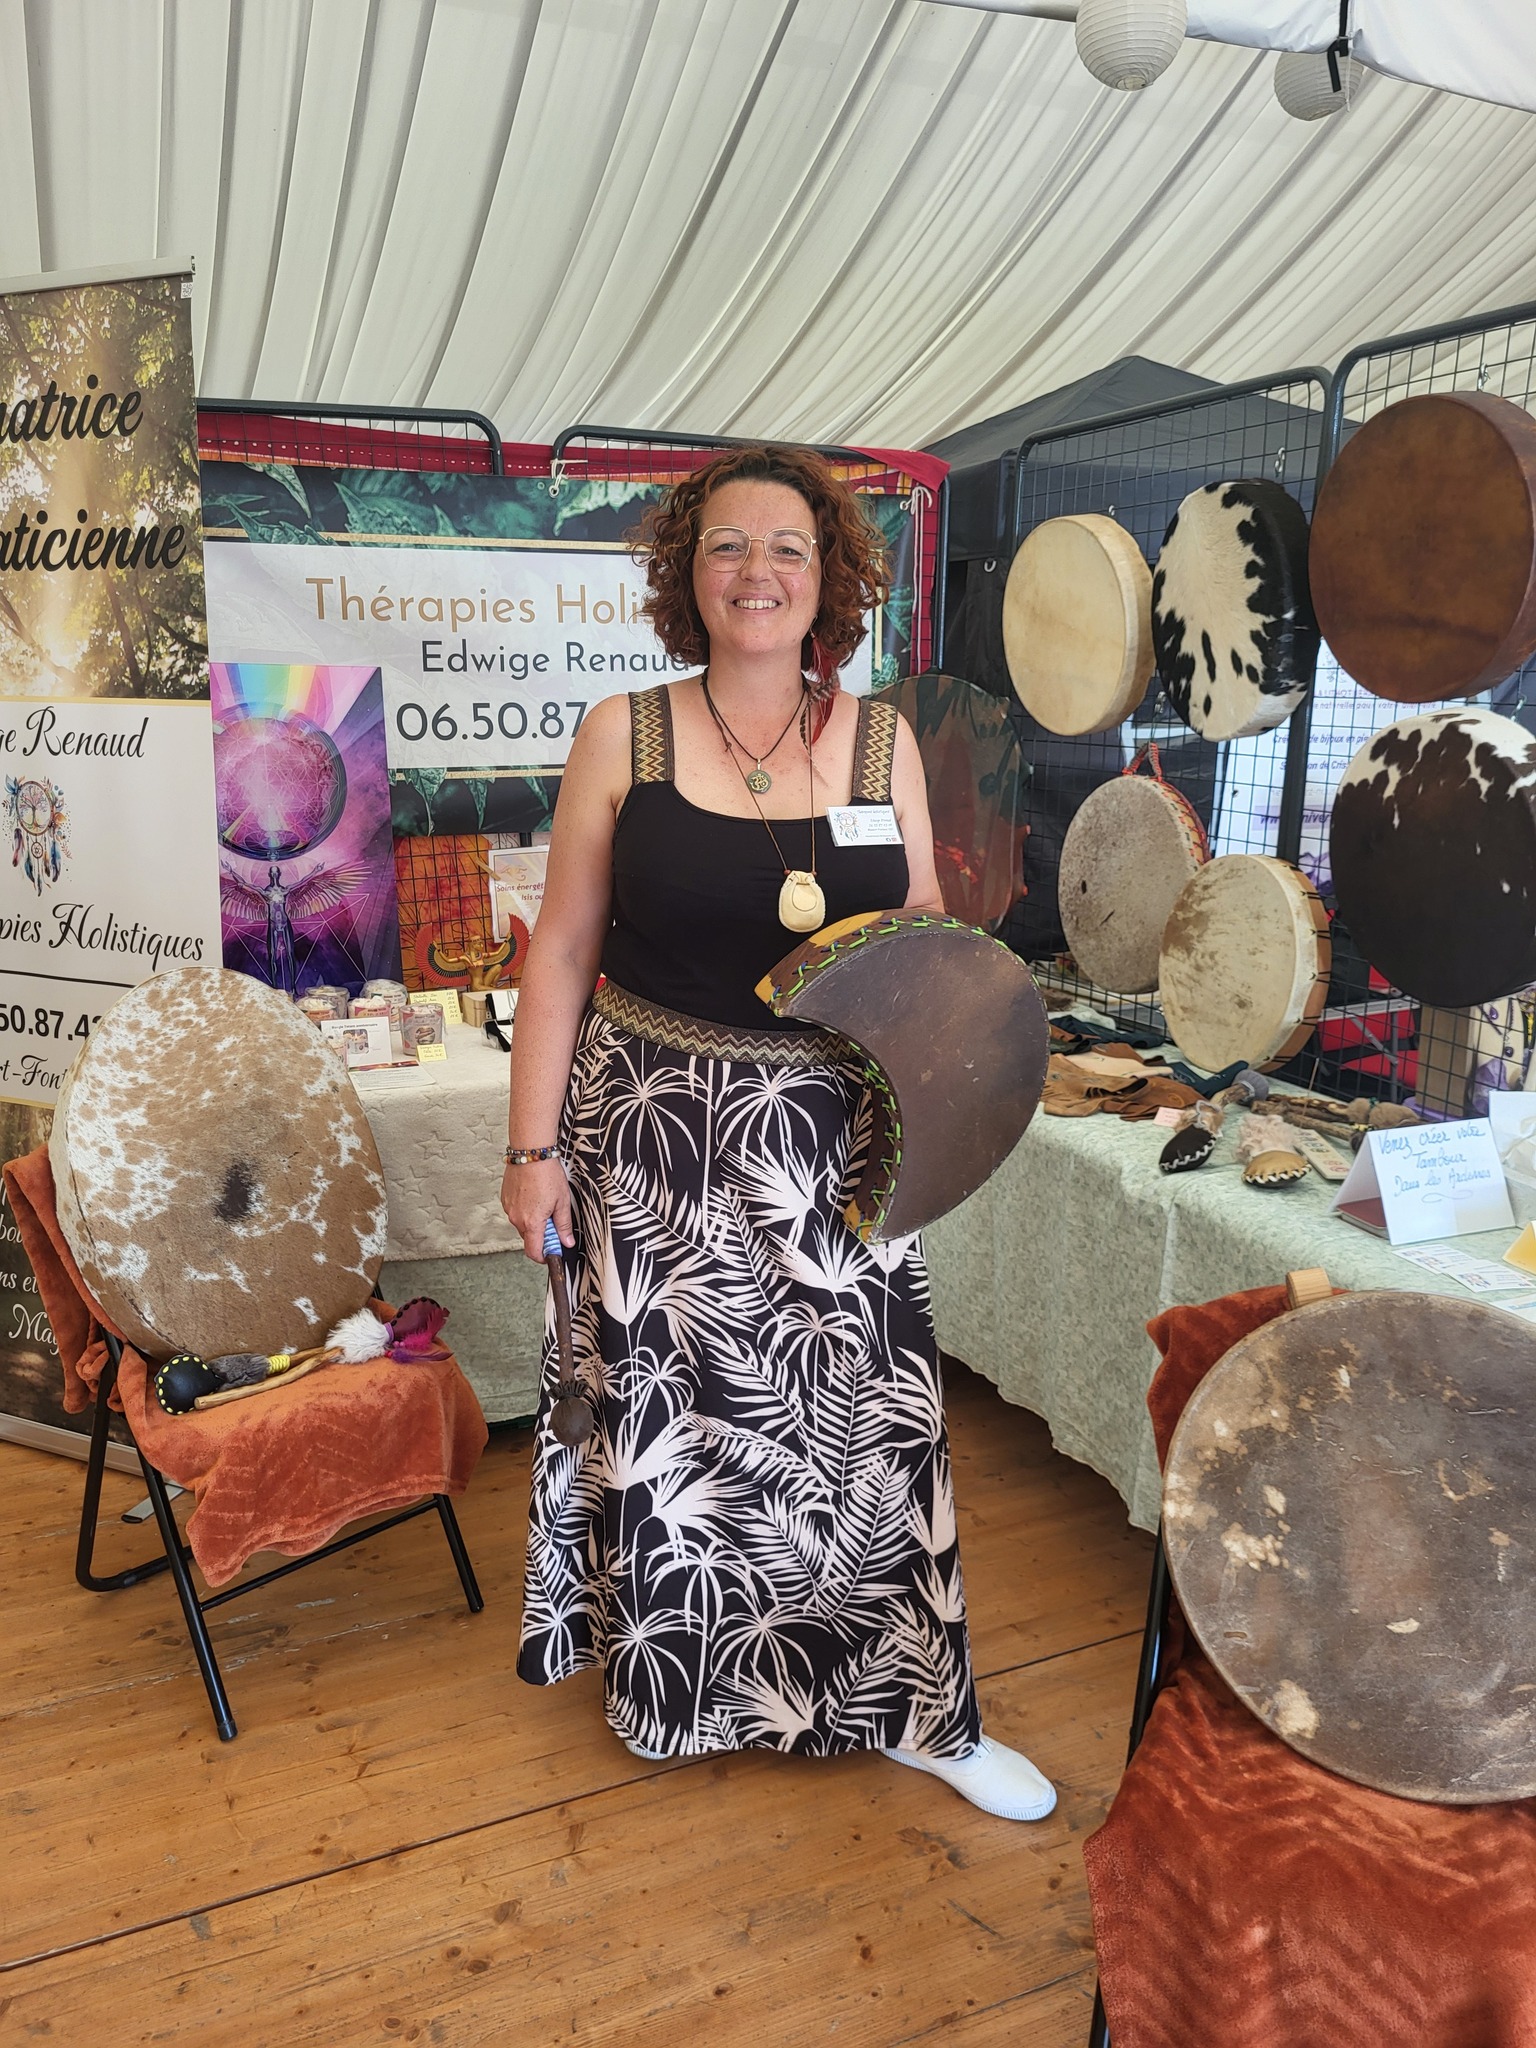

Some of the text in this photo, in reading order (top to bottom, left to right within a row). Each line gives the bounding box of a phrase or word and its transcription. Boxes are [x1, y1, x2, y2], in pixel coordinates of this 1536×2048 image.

[305, 576, 654, 633] Thérapies Holi
[422, 640, 550, 681] Edwige
[23, 706, 149, 758] Renaud
[48, 903, 204, 972] Holistiques
[0, 1004, 103, 1041] 50.87.4
